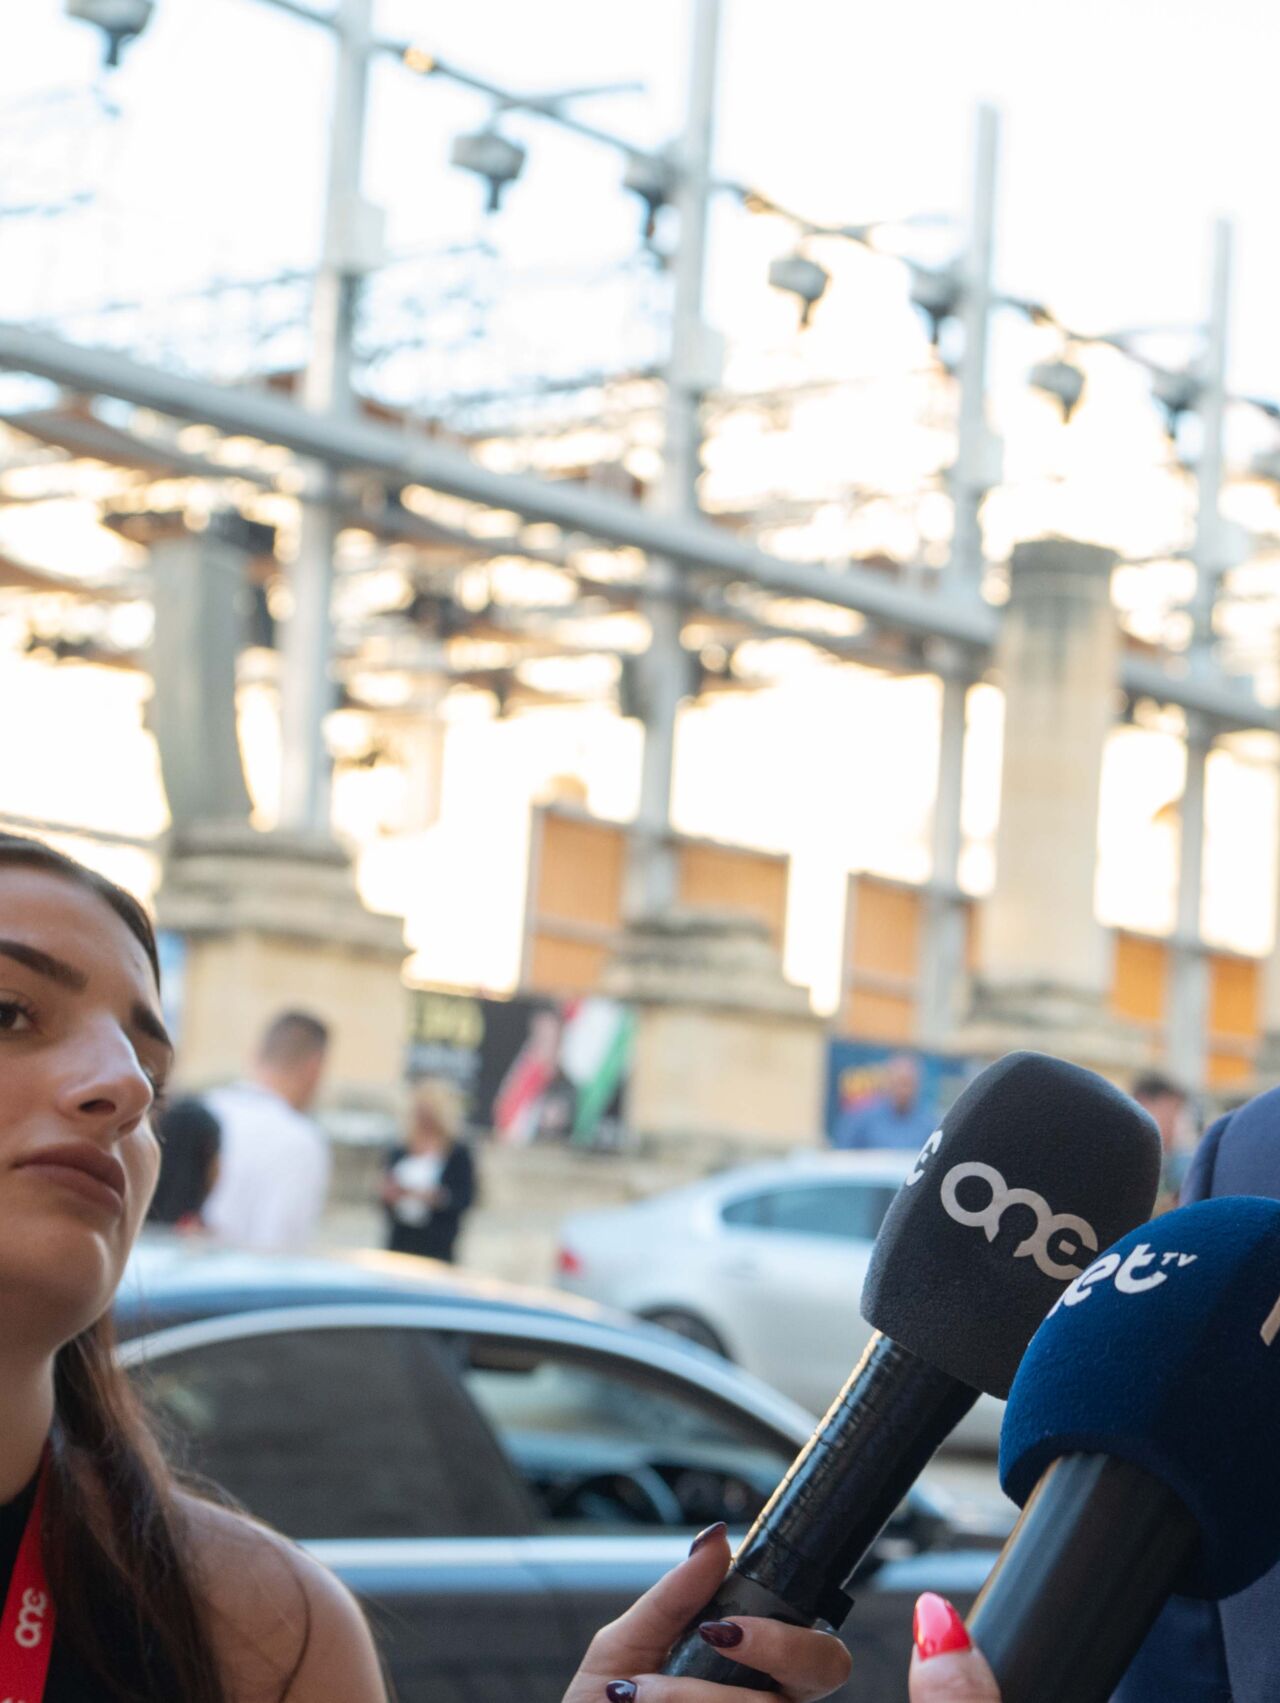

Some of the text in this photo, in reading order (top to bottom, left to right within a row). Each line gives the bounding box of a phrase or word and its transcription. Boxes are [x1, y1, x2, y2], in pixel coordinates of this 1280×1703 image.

[941, 1161, 1099, 1280] one
[1046, 1243, 1198, 1319] et TV
